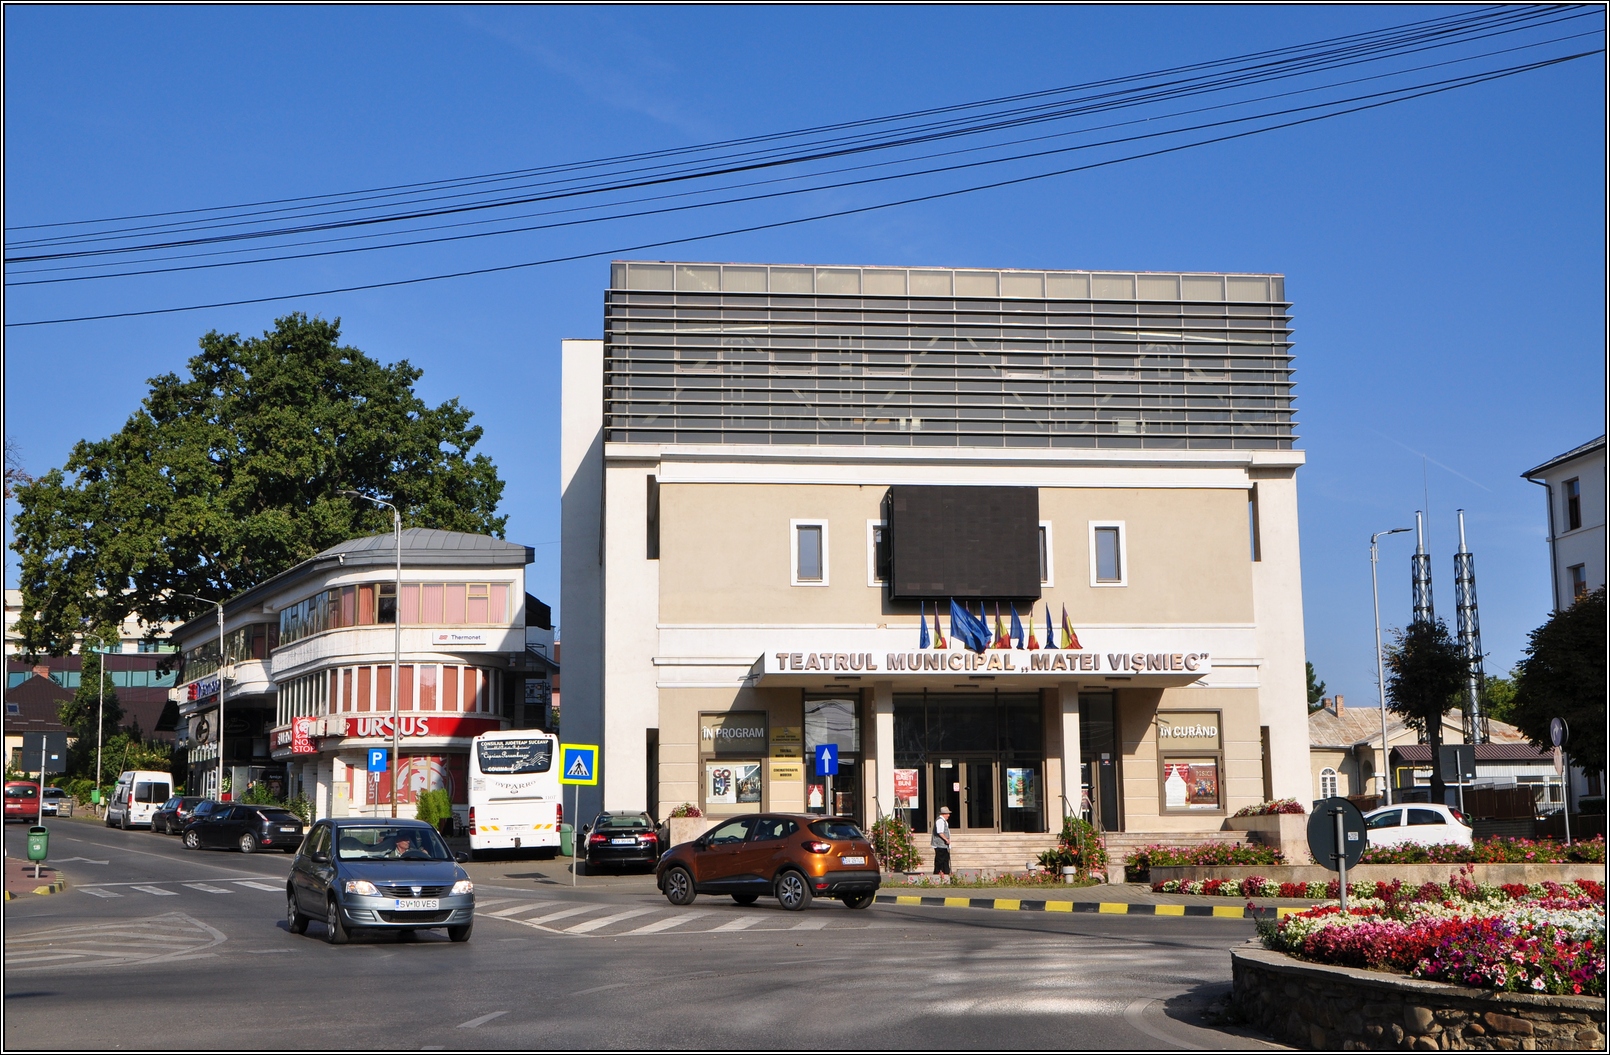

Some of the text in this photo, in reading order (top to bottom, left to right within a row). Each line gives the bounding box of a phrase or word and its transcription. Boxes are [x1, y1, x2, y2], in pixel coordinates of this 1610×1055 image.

[776, 653, 877, 670] TEATRUL
[887, 653, 1015, 671] MUNICIPAL
[357, 714, 429, 741] URSUS
[703, 726, 764, 738] ÎN PROGRAM
[1160, 724, 1218, 736] ÎN CURÂND
[372, 752, 382, 765] P
[713, 769, 731, 778] GO
[400, 900, 437, 908] SV 10 VES
